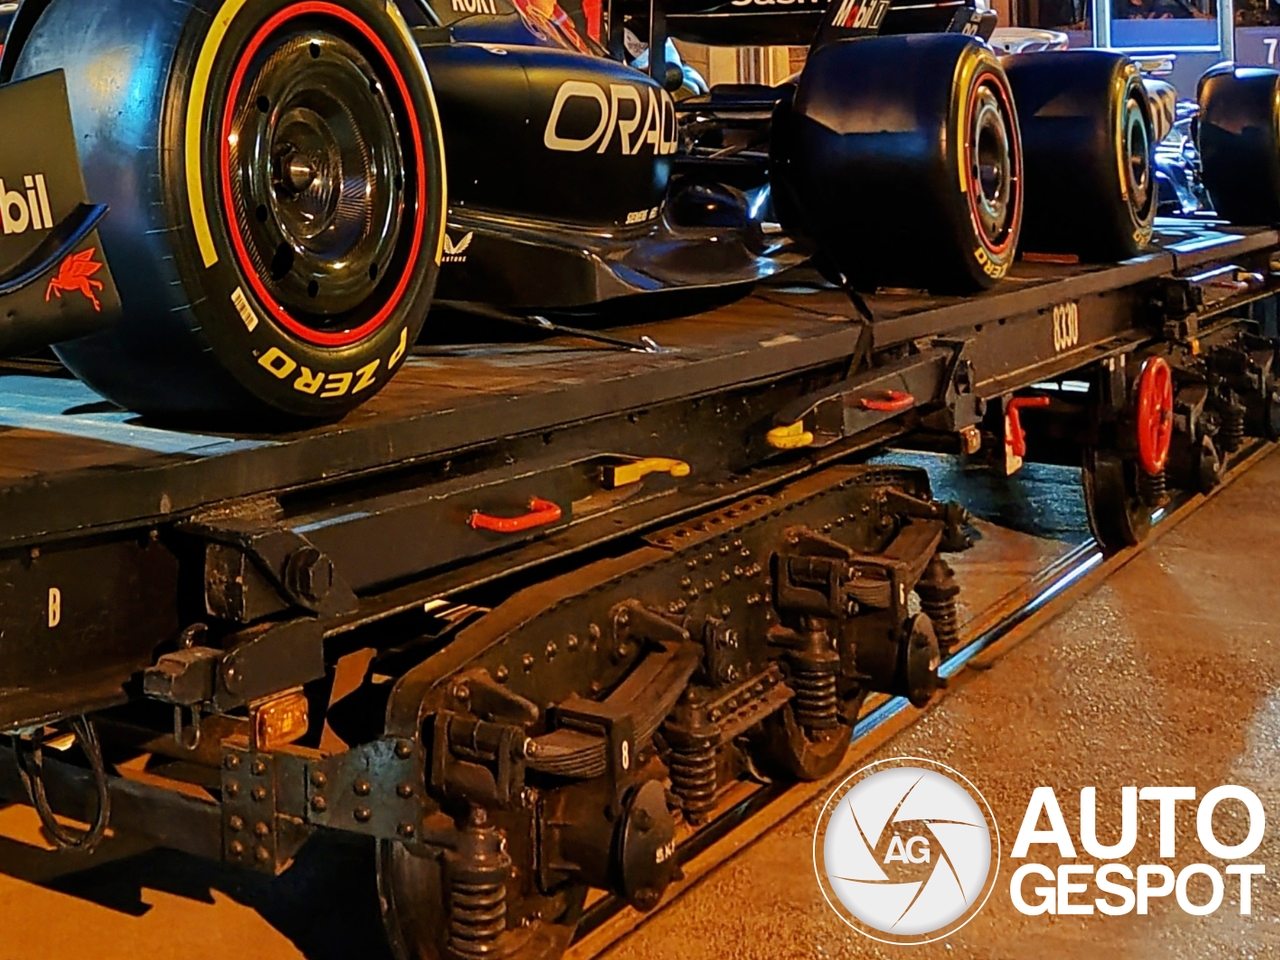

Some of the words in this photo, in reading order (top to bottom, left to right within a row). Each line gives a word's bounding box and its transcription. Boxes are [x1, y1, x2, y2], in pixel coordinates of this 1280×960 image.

[387, 326, 408, 370] P
[1052, 301, 1079, 352] 8330
[257, 346, 381, 398] ZERO
